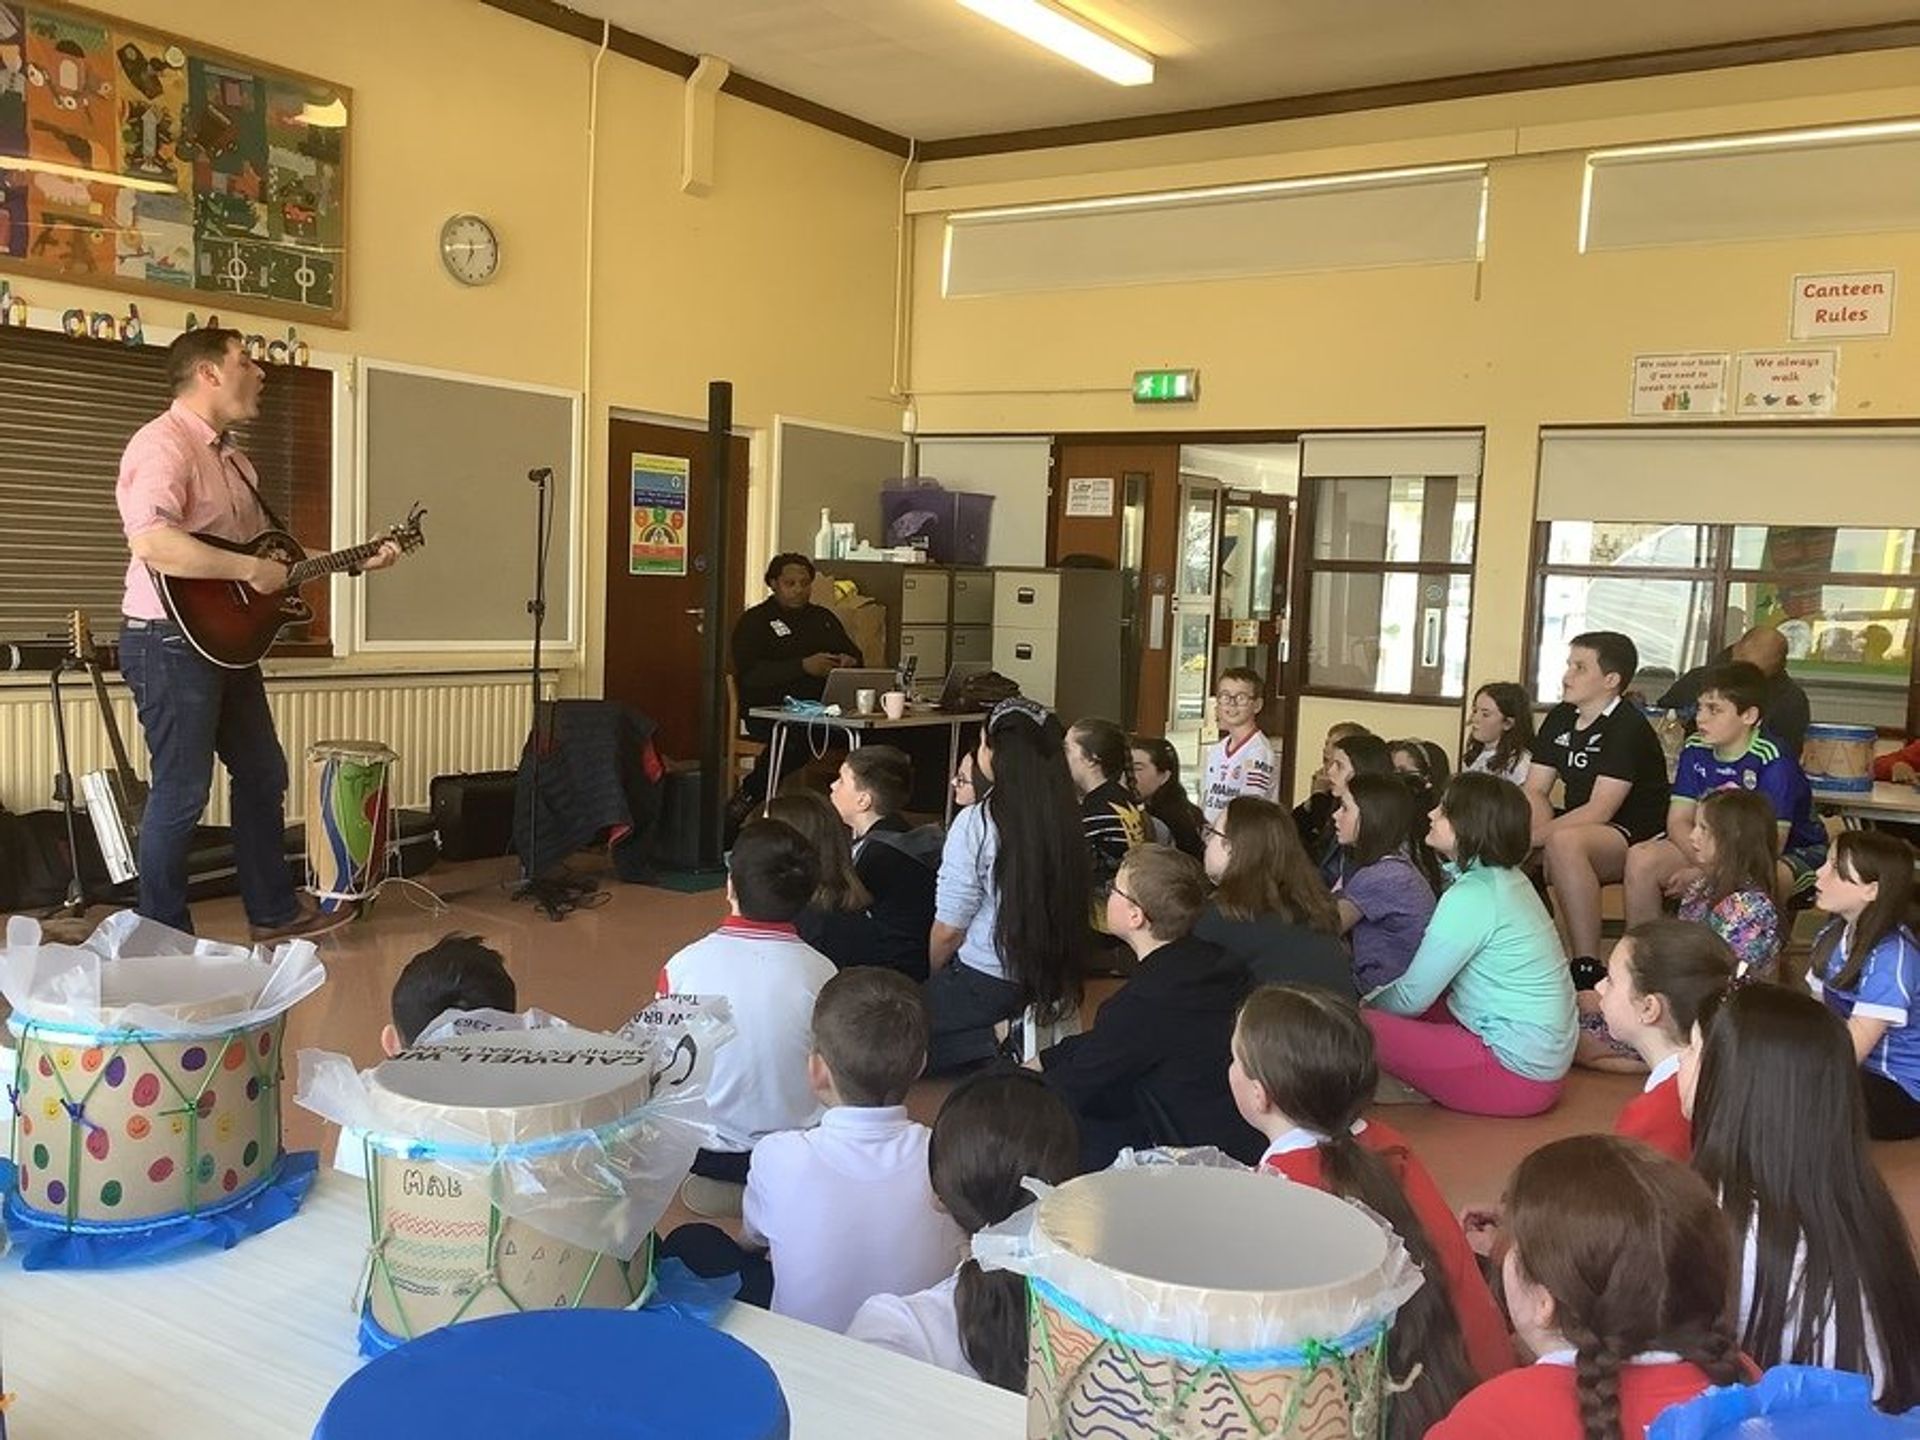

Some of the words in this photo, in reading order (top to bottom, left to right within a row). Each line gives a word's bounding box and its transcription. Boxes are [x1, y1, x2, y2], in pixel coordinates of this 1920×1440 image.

[1803, 282, 1884, 298] Canteen
[1815, 307, 1869, 323] Rules
[62, 302, 144, 347] and
[1754, 358, 1773, 368] We
[1776, 356, 1819, 368] always
[1771, 371, 1799, 381] walk
[461, 1053, 645, 1066] CALDWELL
